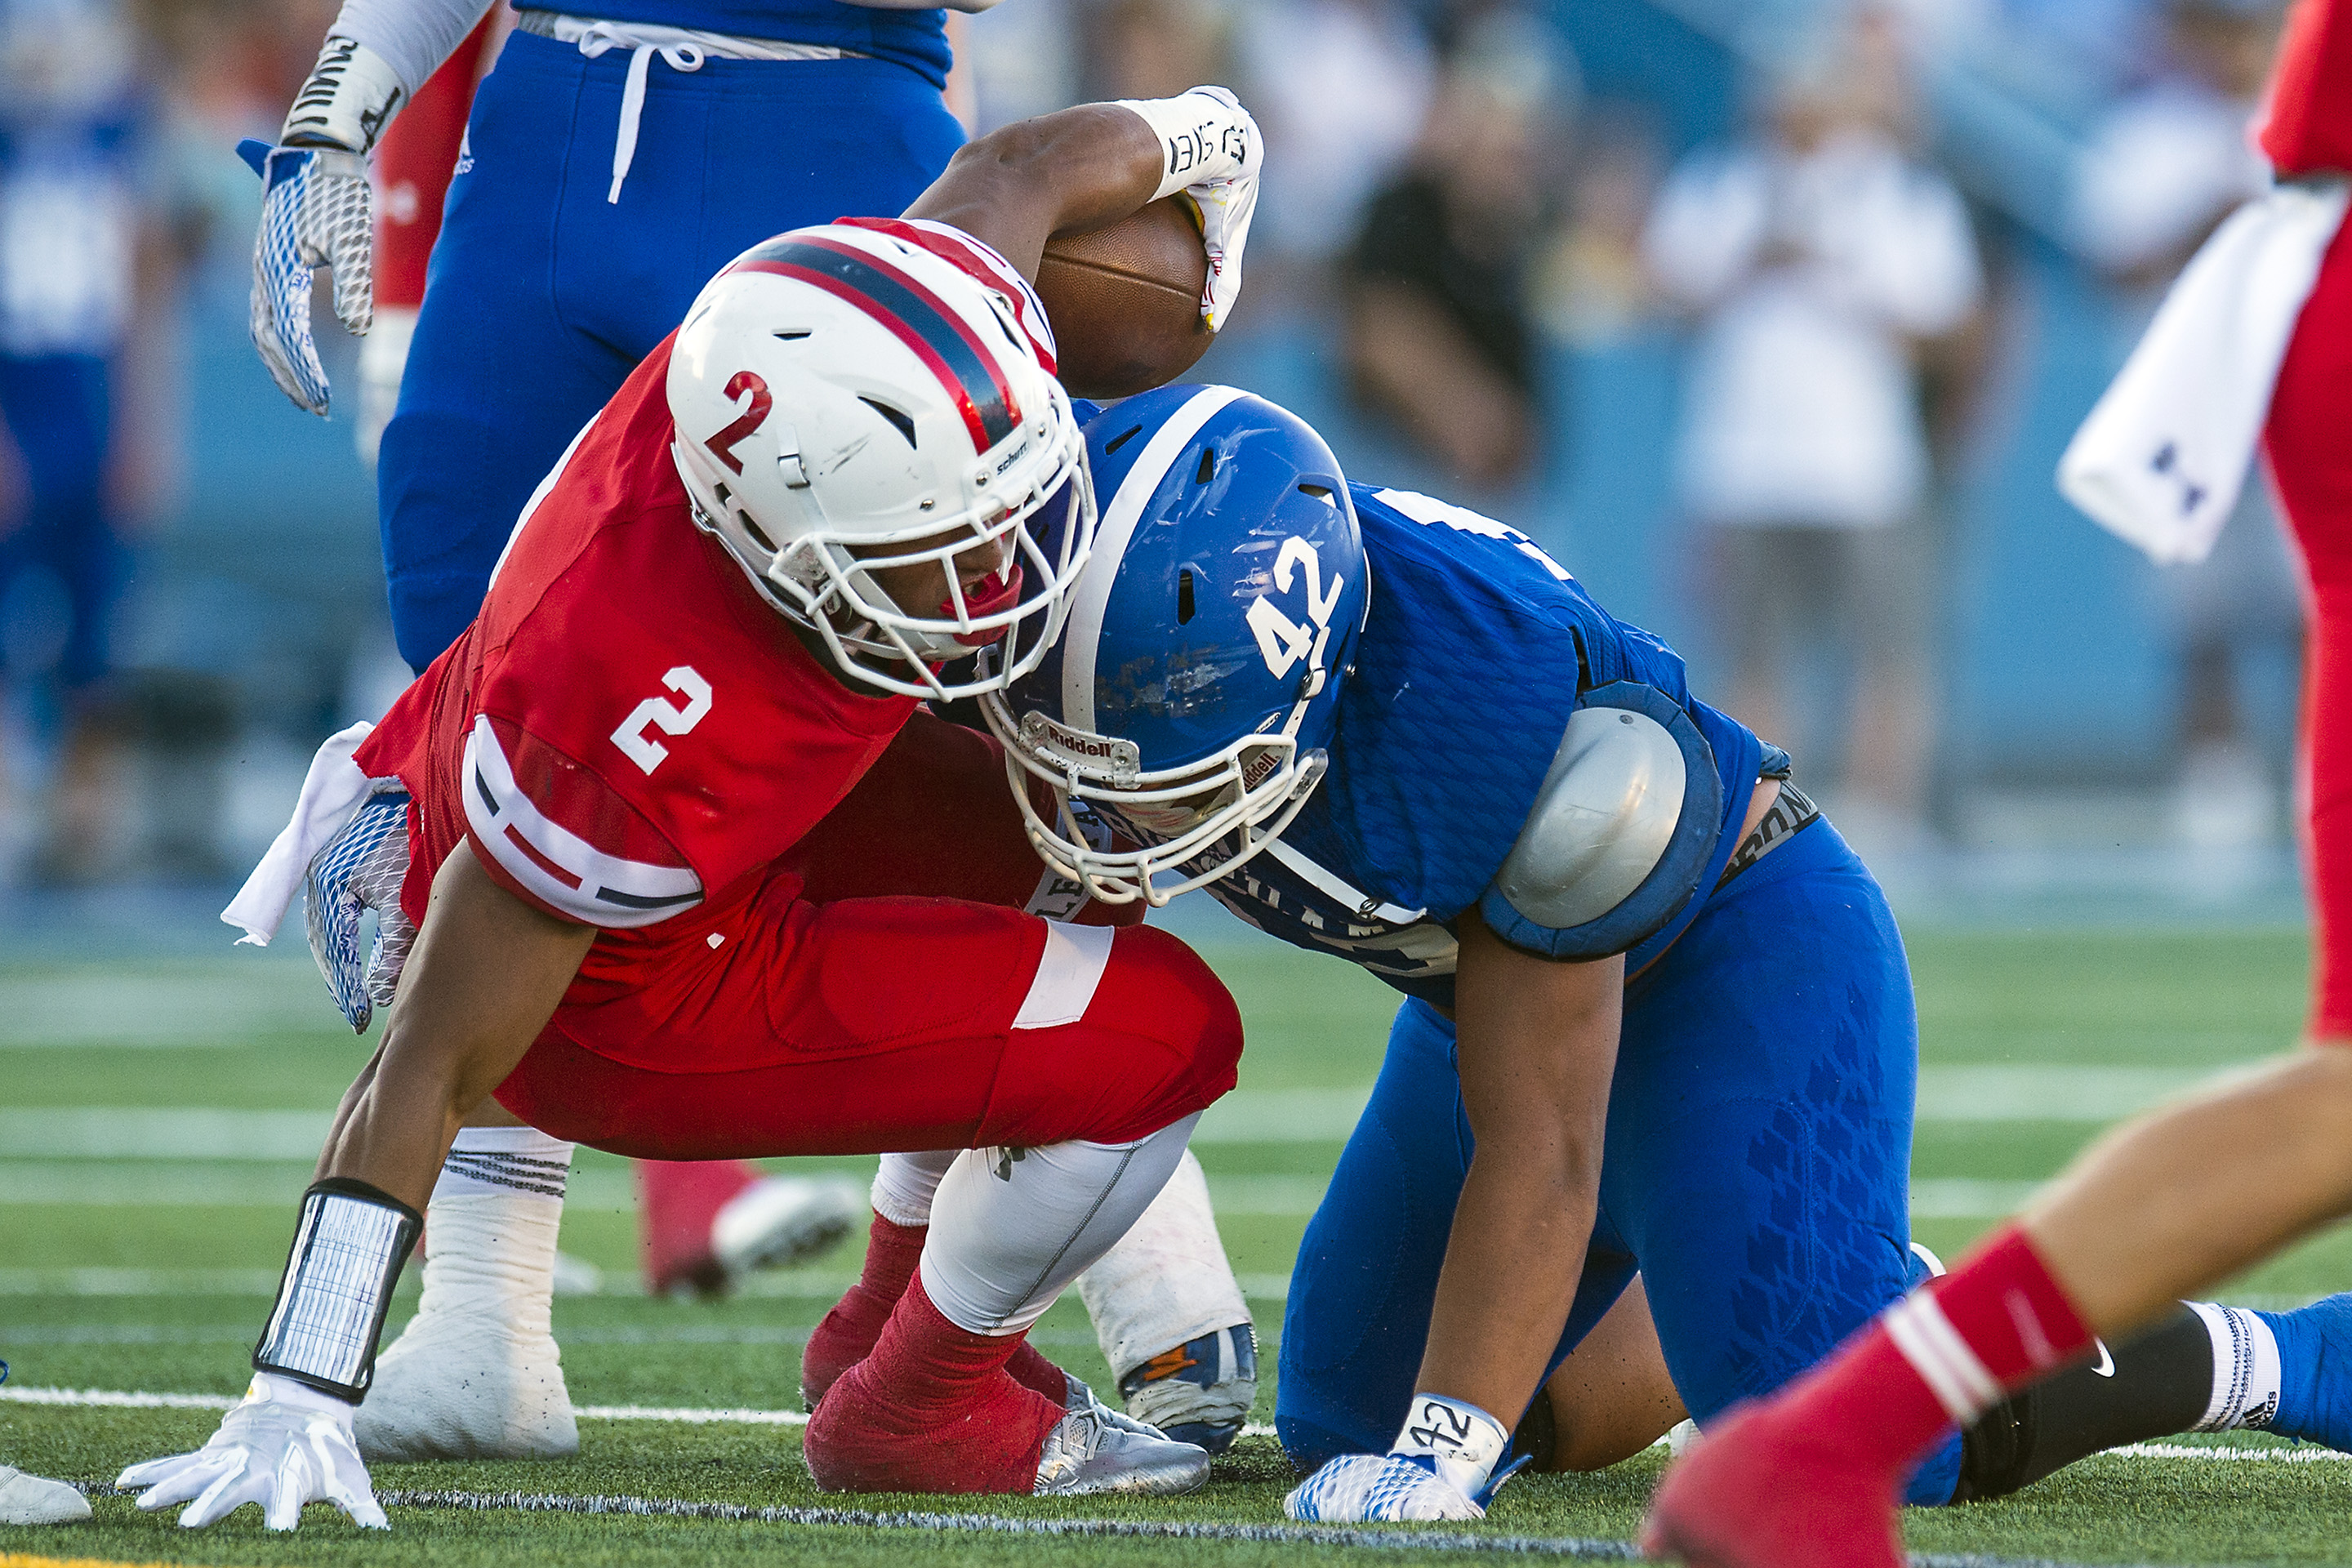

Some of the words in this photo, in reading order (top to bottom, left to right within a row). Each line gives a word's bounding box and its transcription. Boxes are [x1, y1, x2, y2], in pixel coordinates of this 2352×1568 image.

[703, 371, 773, 478] 2
[996, 441, 1027, 476] schutt
[1245, 535, 1344, 681] 42
[610, 666, 712, 776] 2
[1048, 724, 1111, 759] Riddell
[1244, 751, 1278, 791] iddell
[1410, 1401, 1472, 1448] 42
